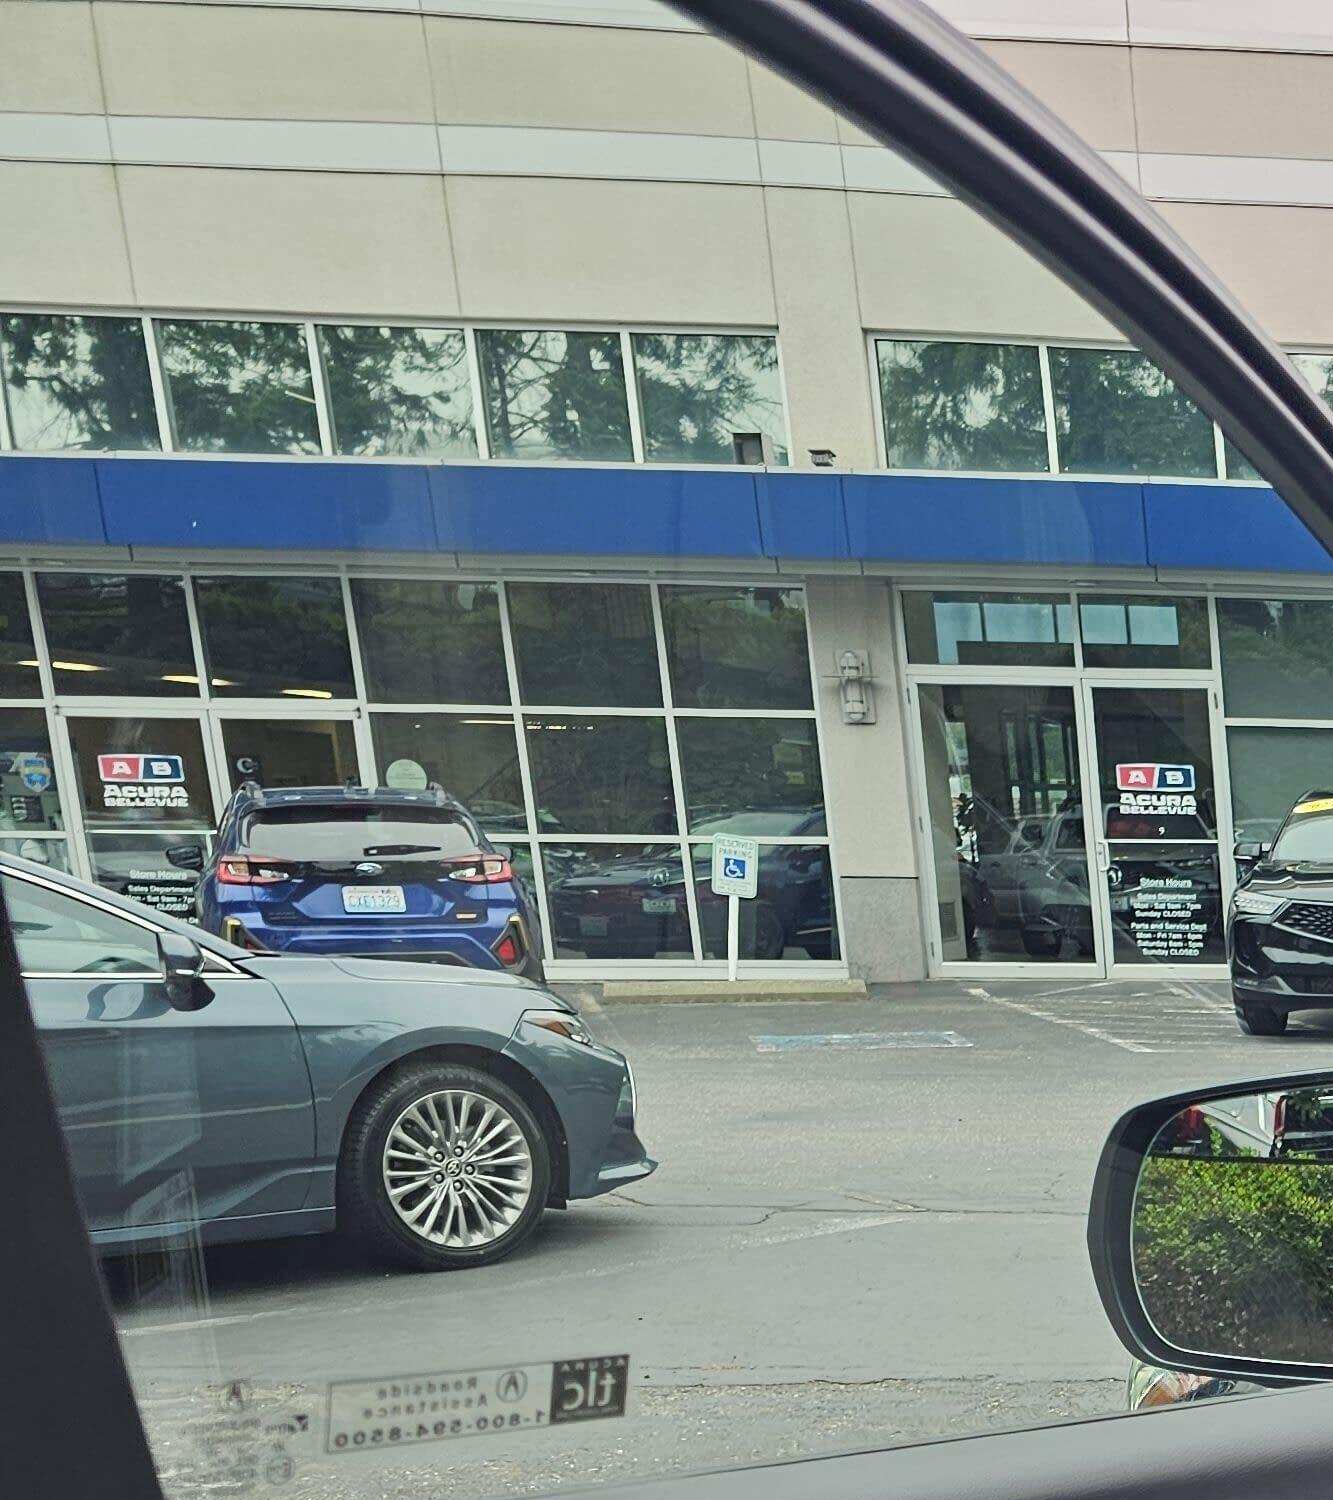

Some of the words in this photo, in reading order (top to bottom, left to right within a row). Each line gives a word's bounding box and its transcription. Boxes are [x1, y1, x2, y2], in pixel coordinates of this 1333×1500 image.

[112, 761, 132, 775] A
[150, 761, 172, 776] B
[1128, 770, 1147, 784] A
[1164, 771, 1184, 785] B
[103, 784, 189, 798] ACURA
[104, 797, 189, 807] BELLEVUE
[1120, 793, 1197, 807] ACURA
[1119, 805, 1197, 815] BELLEVUE
[129, 869, 156, 880] Store
[157, 870, 187, 880] Hours
[1140, 877, 1164, 888] Store
[1165, 878, 1192, 888] Hours
[1162, 910, 1192, 918] CLOSED
[1169, 948, 1200, 956] CLOSED
